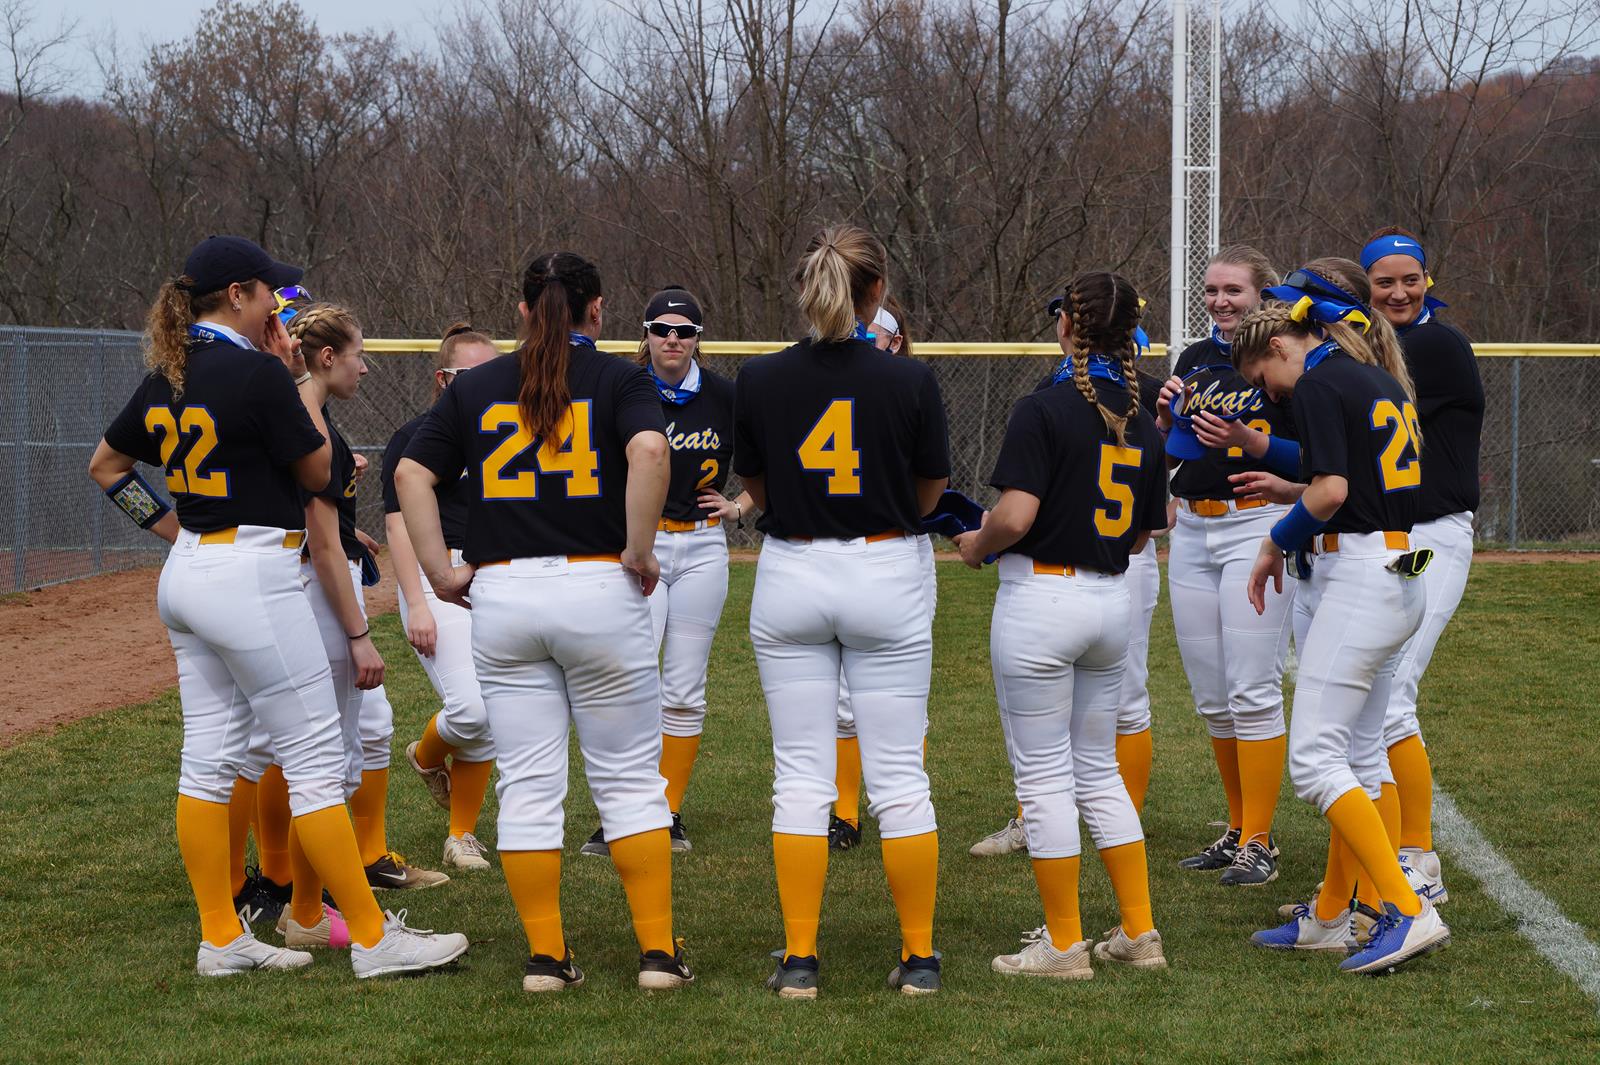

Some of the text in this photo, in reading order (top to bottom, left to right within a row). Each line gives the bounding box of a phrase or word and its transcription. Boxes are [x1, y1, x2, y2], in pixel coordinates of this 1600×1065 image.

[144, 403, 232, 498] 22
[479, 398, 603, 501] 24
[695, 459, 719, 491] 2
[797, 397, 863, 497] 4
[1092, 441, 1144, 540] 5
